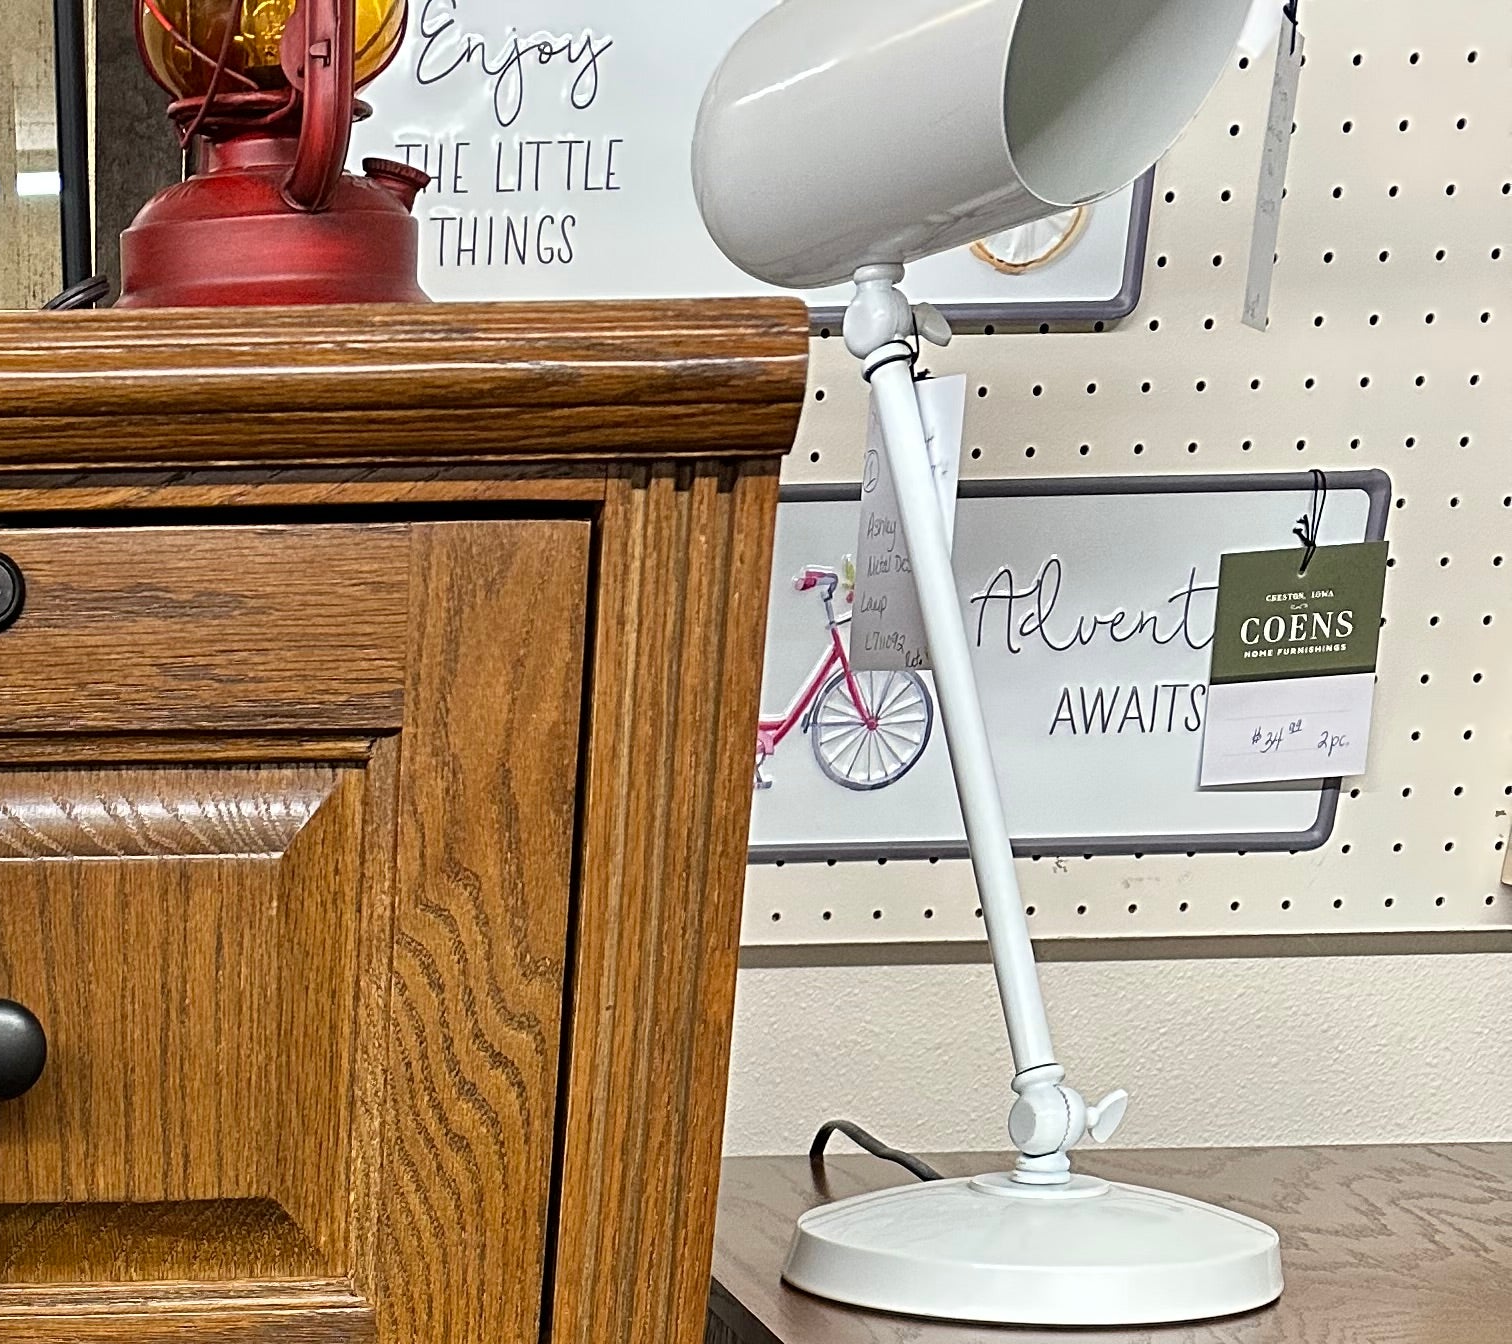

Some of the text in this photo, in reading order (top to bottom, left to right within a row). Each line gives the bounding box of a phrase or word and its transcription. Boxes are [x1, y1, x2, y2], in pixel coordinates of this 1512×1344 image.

[416, 0, 614, 128] Enjoy
[395, 139, 624, 194] THE LITTLE
[429, 214, 577, 267] THINGS
[970, 558, 1219, 654] Advent
[1311, 590, 1334, 599] IOWA
[1240, 609, 1354, 645] COENS
[1244, 643, 1347, 659] HOME FURNISHINGS
[1049, 683, 1206, 735] AWAITS
